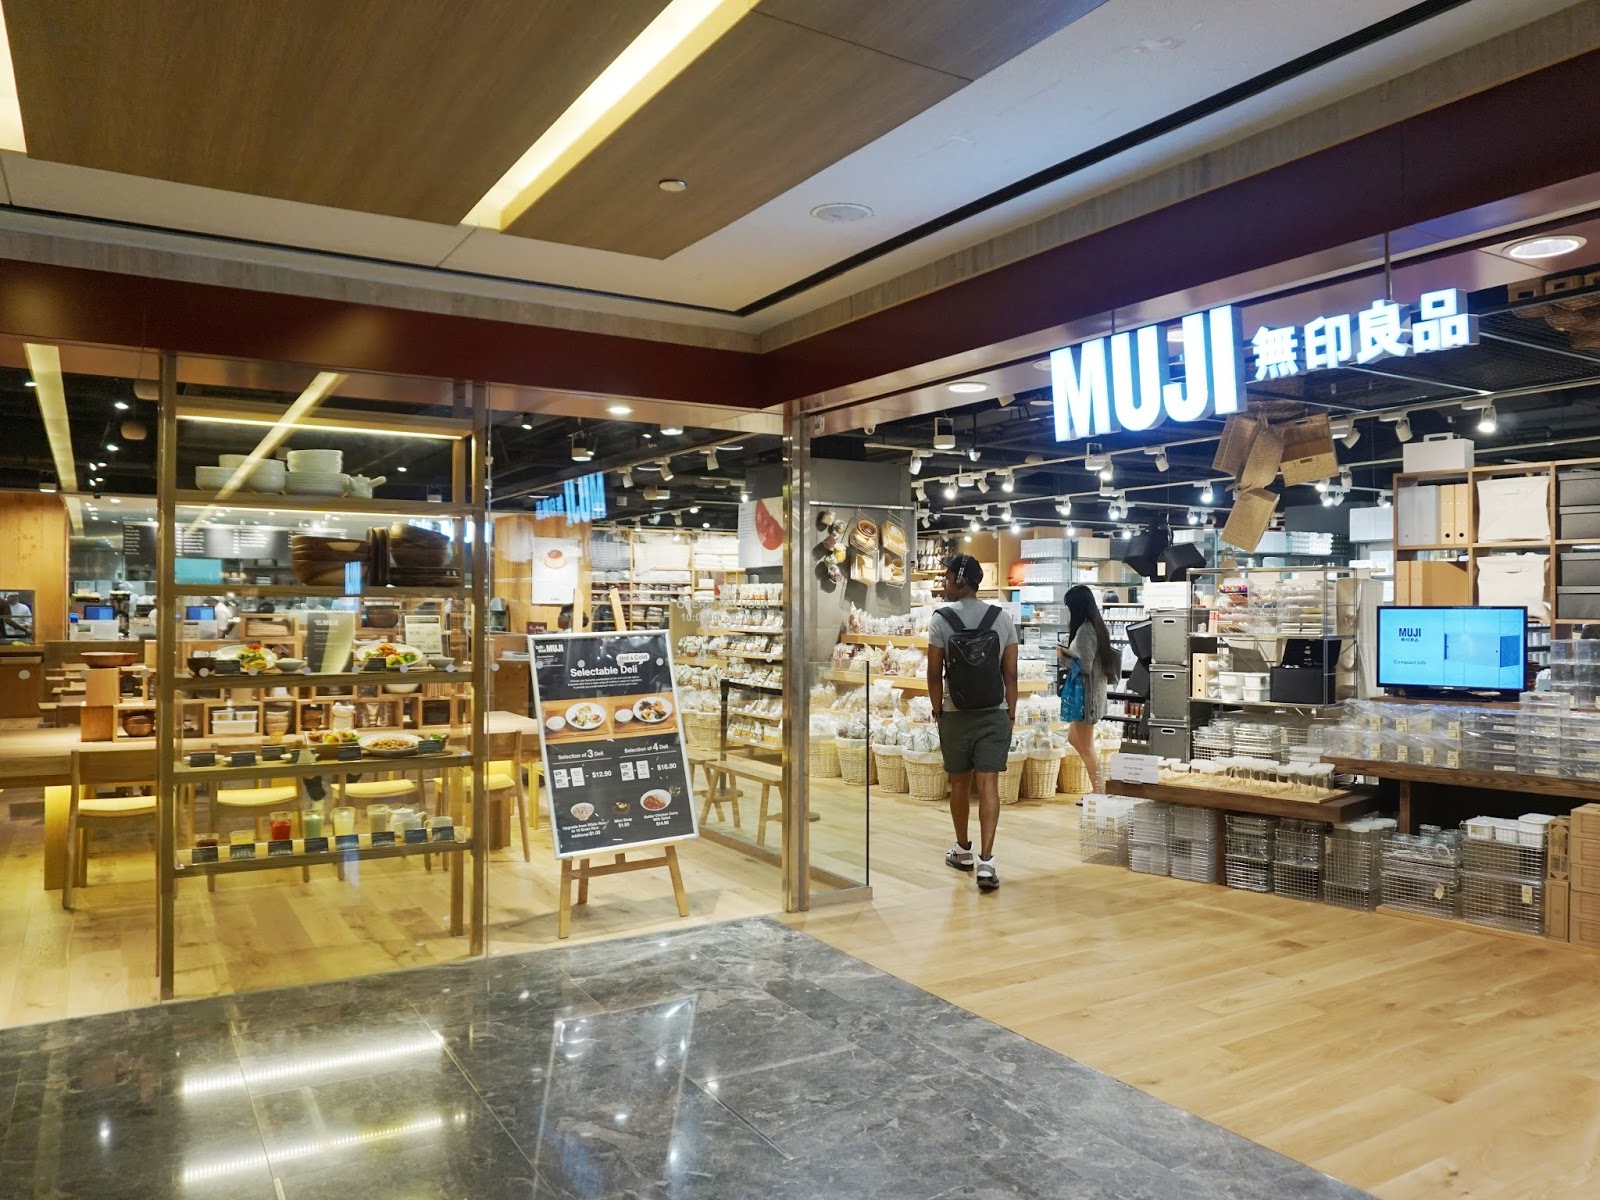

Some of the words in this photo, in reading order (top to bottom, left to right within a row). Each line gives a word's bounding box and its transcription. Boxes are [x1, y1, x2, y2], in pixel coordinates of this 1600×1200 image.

[1252, 288, 1472, 380] 無印良品
[1050, 303, 1242, 442] MUJI
[1399, 628, 1421, 637] MUJI
[546, 644, 564, 652] MUJI
[570, 666, 618, 677] Selectable
[620, 664, 638, 674] Deli
[624, 746, 647, 754] Selection
[652, 742, 659, 751] 4
[587, 749, 594, 758] 3
[656, 762, 677, 771] $16.90
[591, 769, 612, 778] $12.90
